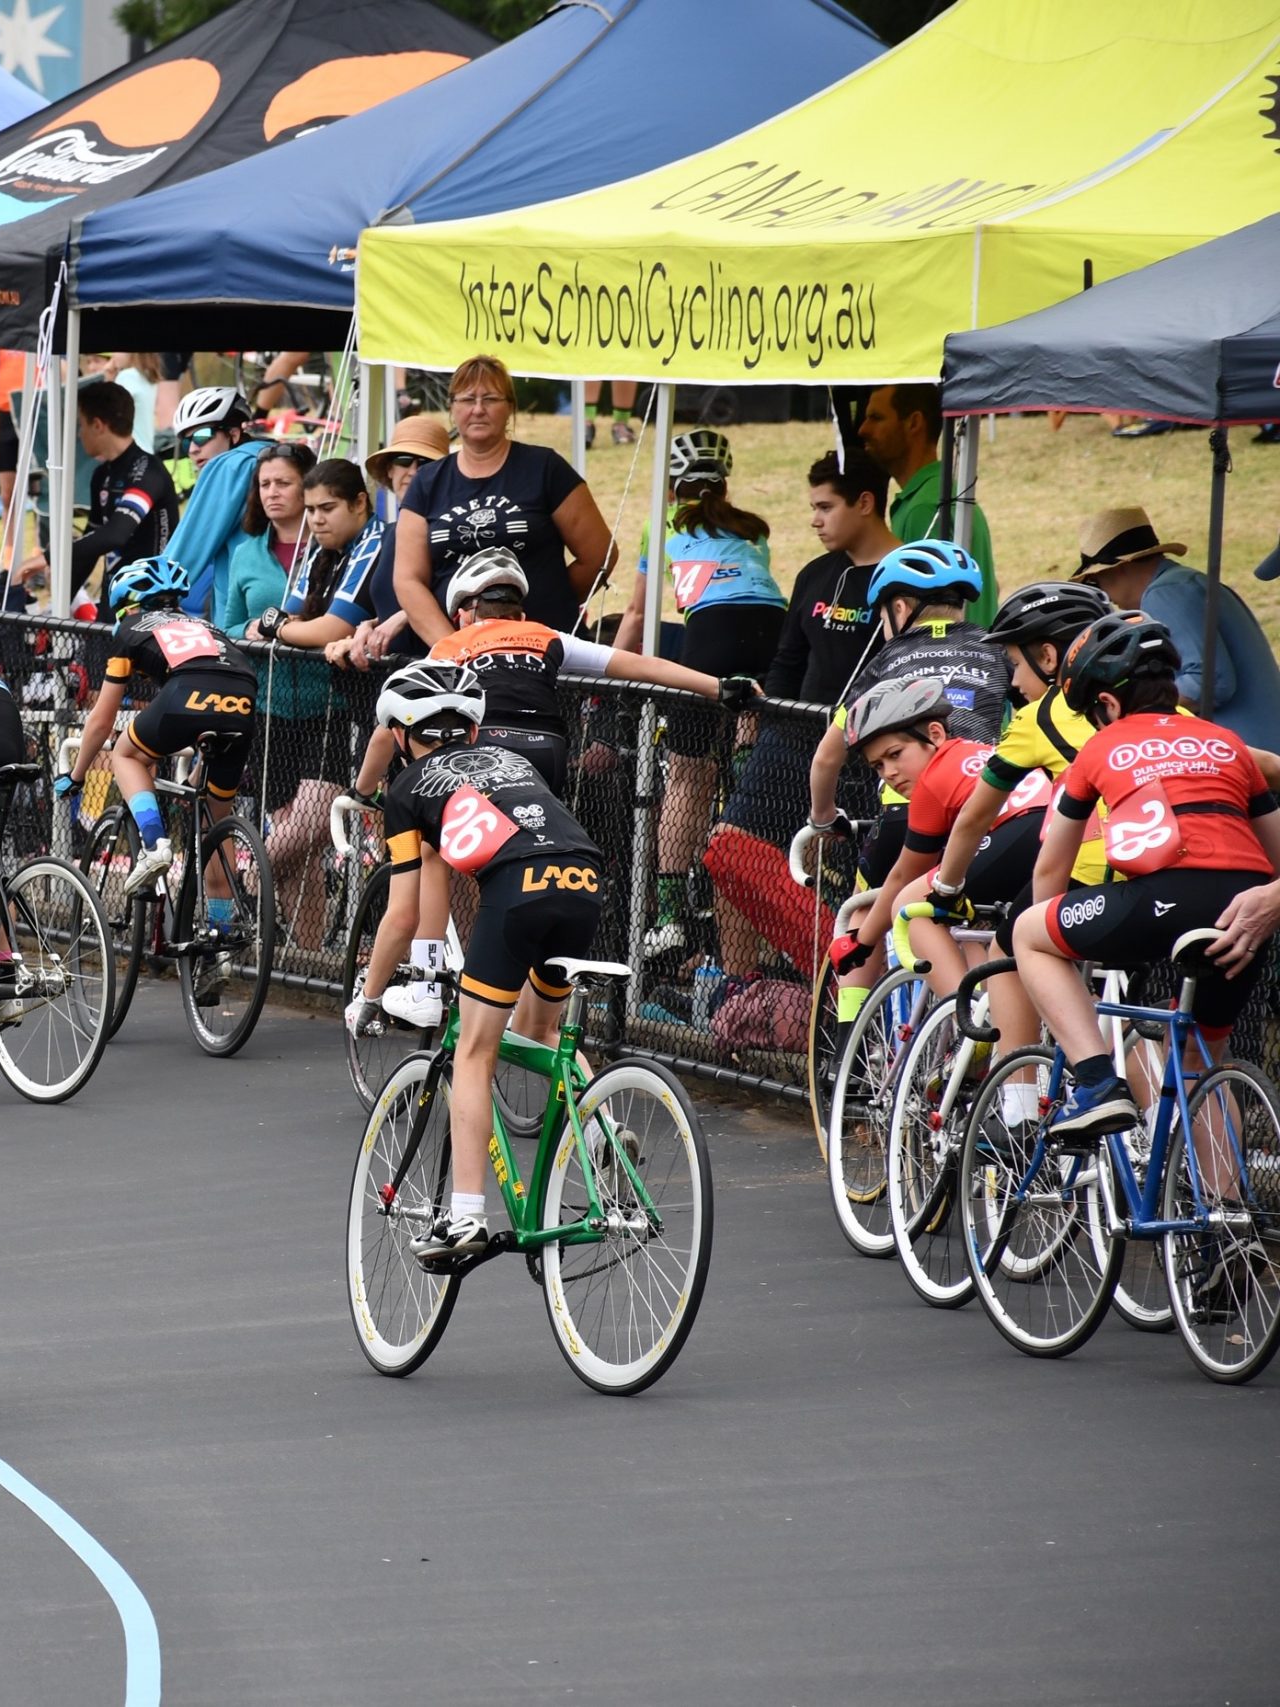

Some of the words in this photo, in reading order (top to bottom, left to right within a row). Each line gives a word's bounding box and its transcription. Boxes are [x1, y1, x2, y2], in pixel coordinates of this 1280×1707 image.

[460, 260, 877, 369] InterSchoolCycling.org.au
[439, 495, 522, 522] PRETTY
[159, 623, 212, 655] 25
[185, 690, 252, 715] LACC
[1109, 737, 1236, 771] DHBC
[1132, 761, 1189, 777] DULWICH
[440, 797, 498, 860] 26
[1111, 800, 1173, 861] 28
[522, 865, 599, 893] LACC
[1060, 895, 1105, 928] DHBC
